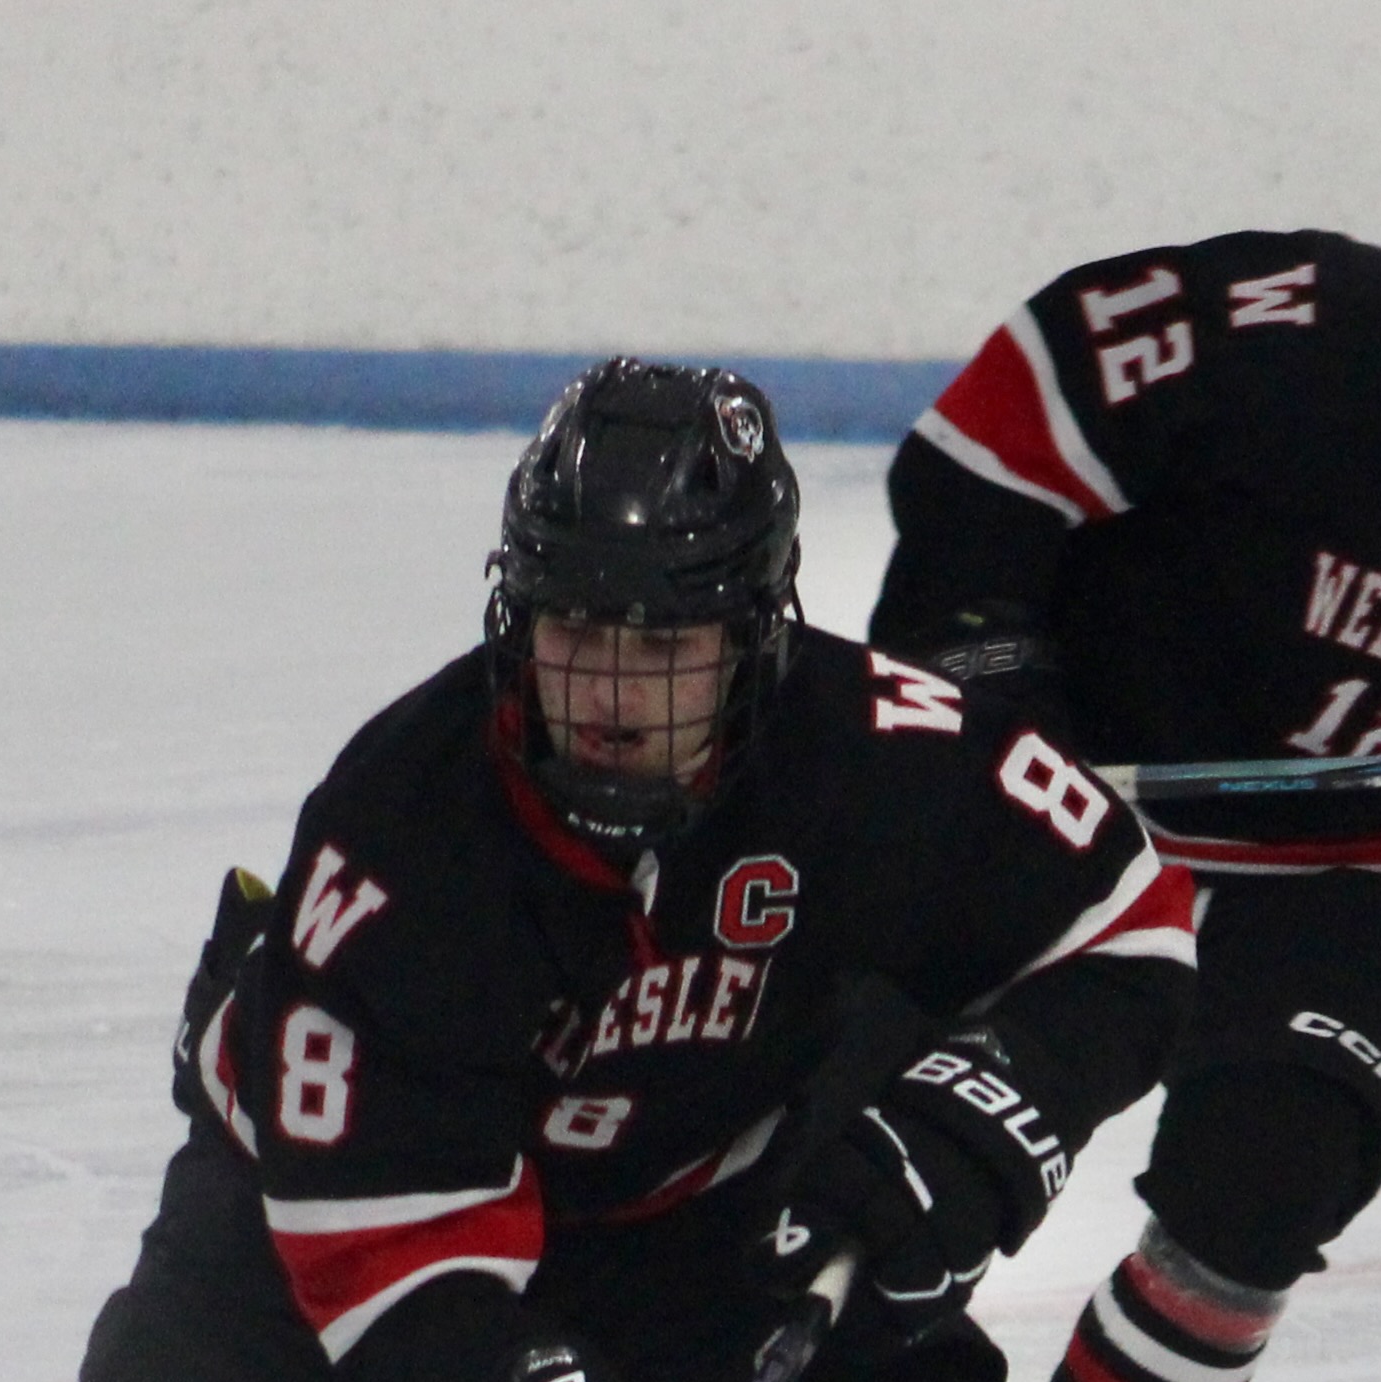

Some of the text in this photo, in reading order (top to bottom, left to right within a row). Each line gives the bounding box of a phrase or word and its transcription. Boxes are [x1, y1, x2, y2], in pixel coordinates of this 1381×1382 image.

[1078, 266, 1195, 406] 12
[1227, 262, 1316, 329] W
[868, 649, 964, 734] W
[998, 730, 1110, 850] 8
[291, 843, 390, 969] W
[713, 854, 800, 950] C
[279, 1004, 356, 1144] 8
[542, 1095, 634, 1150] 8
